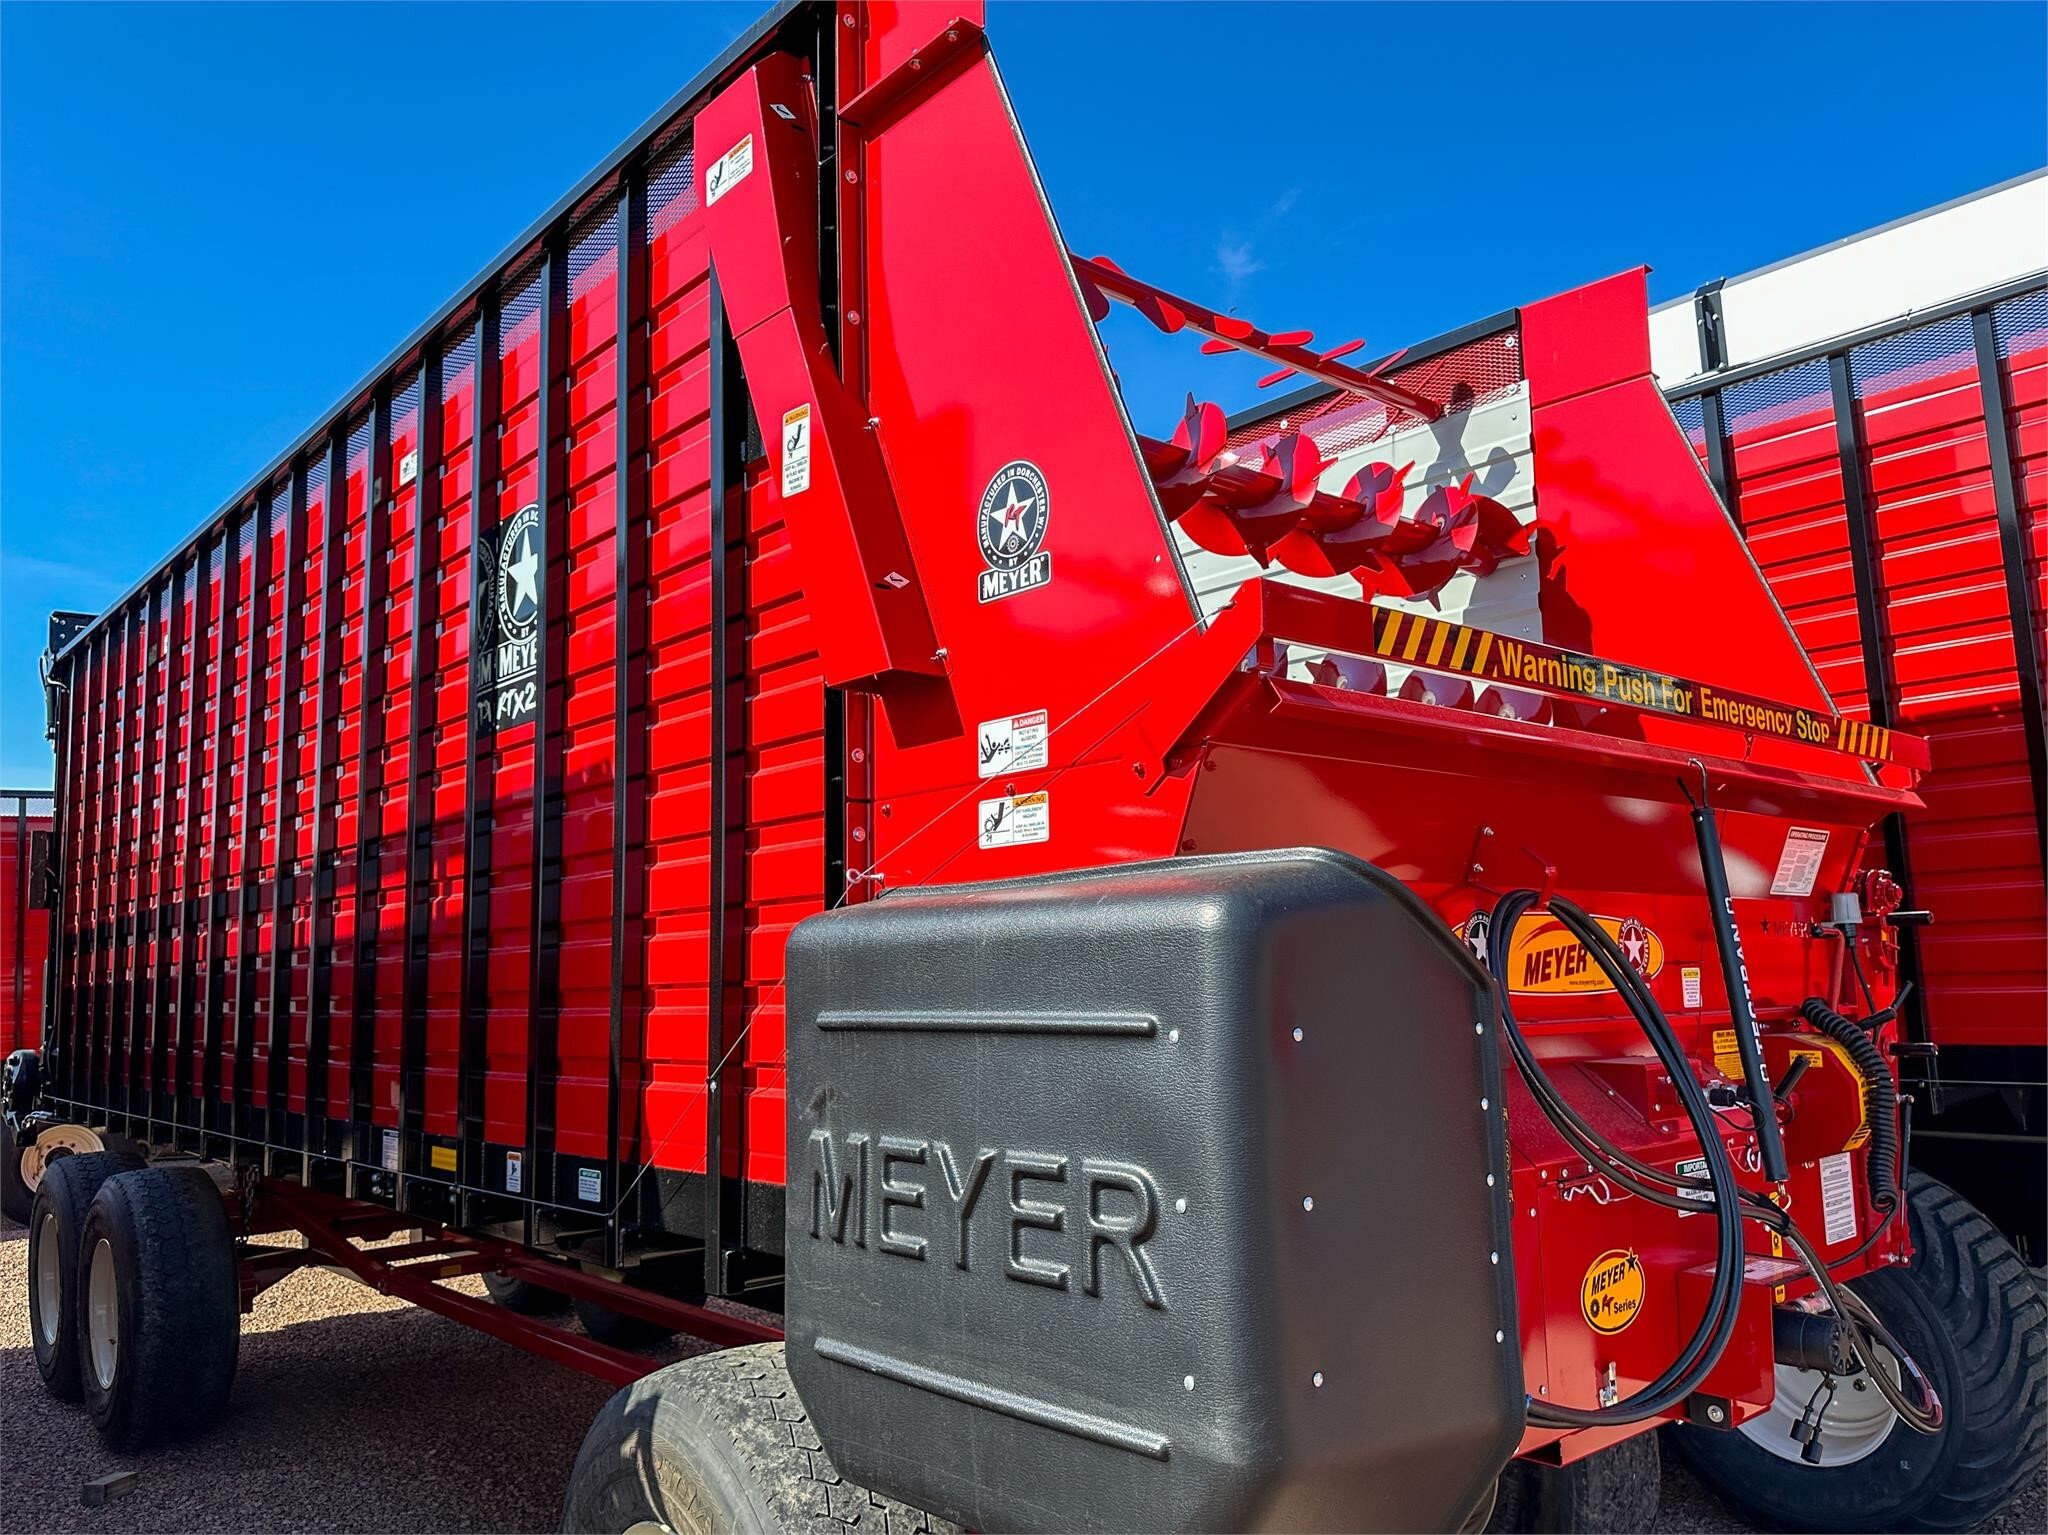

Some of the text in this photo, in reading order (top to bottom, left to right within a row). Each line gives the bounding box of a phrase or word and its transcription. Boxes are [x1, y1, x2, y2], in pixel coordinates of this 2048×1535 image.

[980, 467, 1046, 549] MANUFACTURED IN DORCHESTER WI
[499, 519, 523, 613] MANUFACTURED
[982, 557, 1042, 600] MEYER
[1008, 556, 1018, 568] BY
[521, 626, 529, 639] BY
[499, 639, 537, 678] MEYE
[1499, 639, 1829, 743] Warning Push For Emergency Stop
[1020, 713, 1045, 727] DANGER
[1524, 942, 1588, 987] MEYER
[1683, 1161, 1708, 1173] IMPORTA
[809, 1129, 1168, 1310] MEYER
[1591, 1261, 1626, 1296] MEYER
[1614, 1299, 1636, 1314] Series
